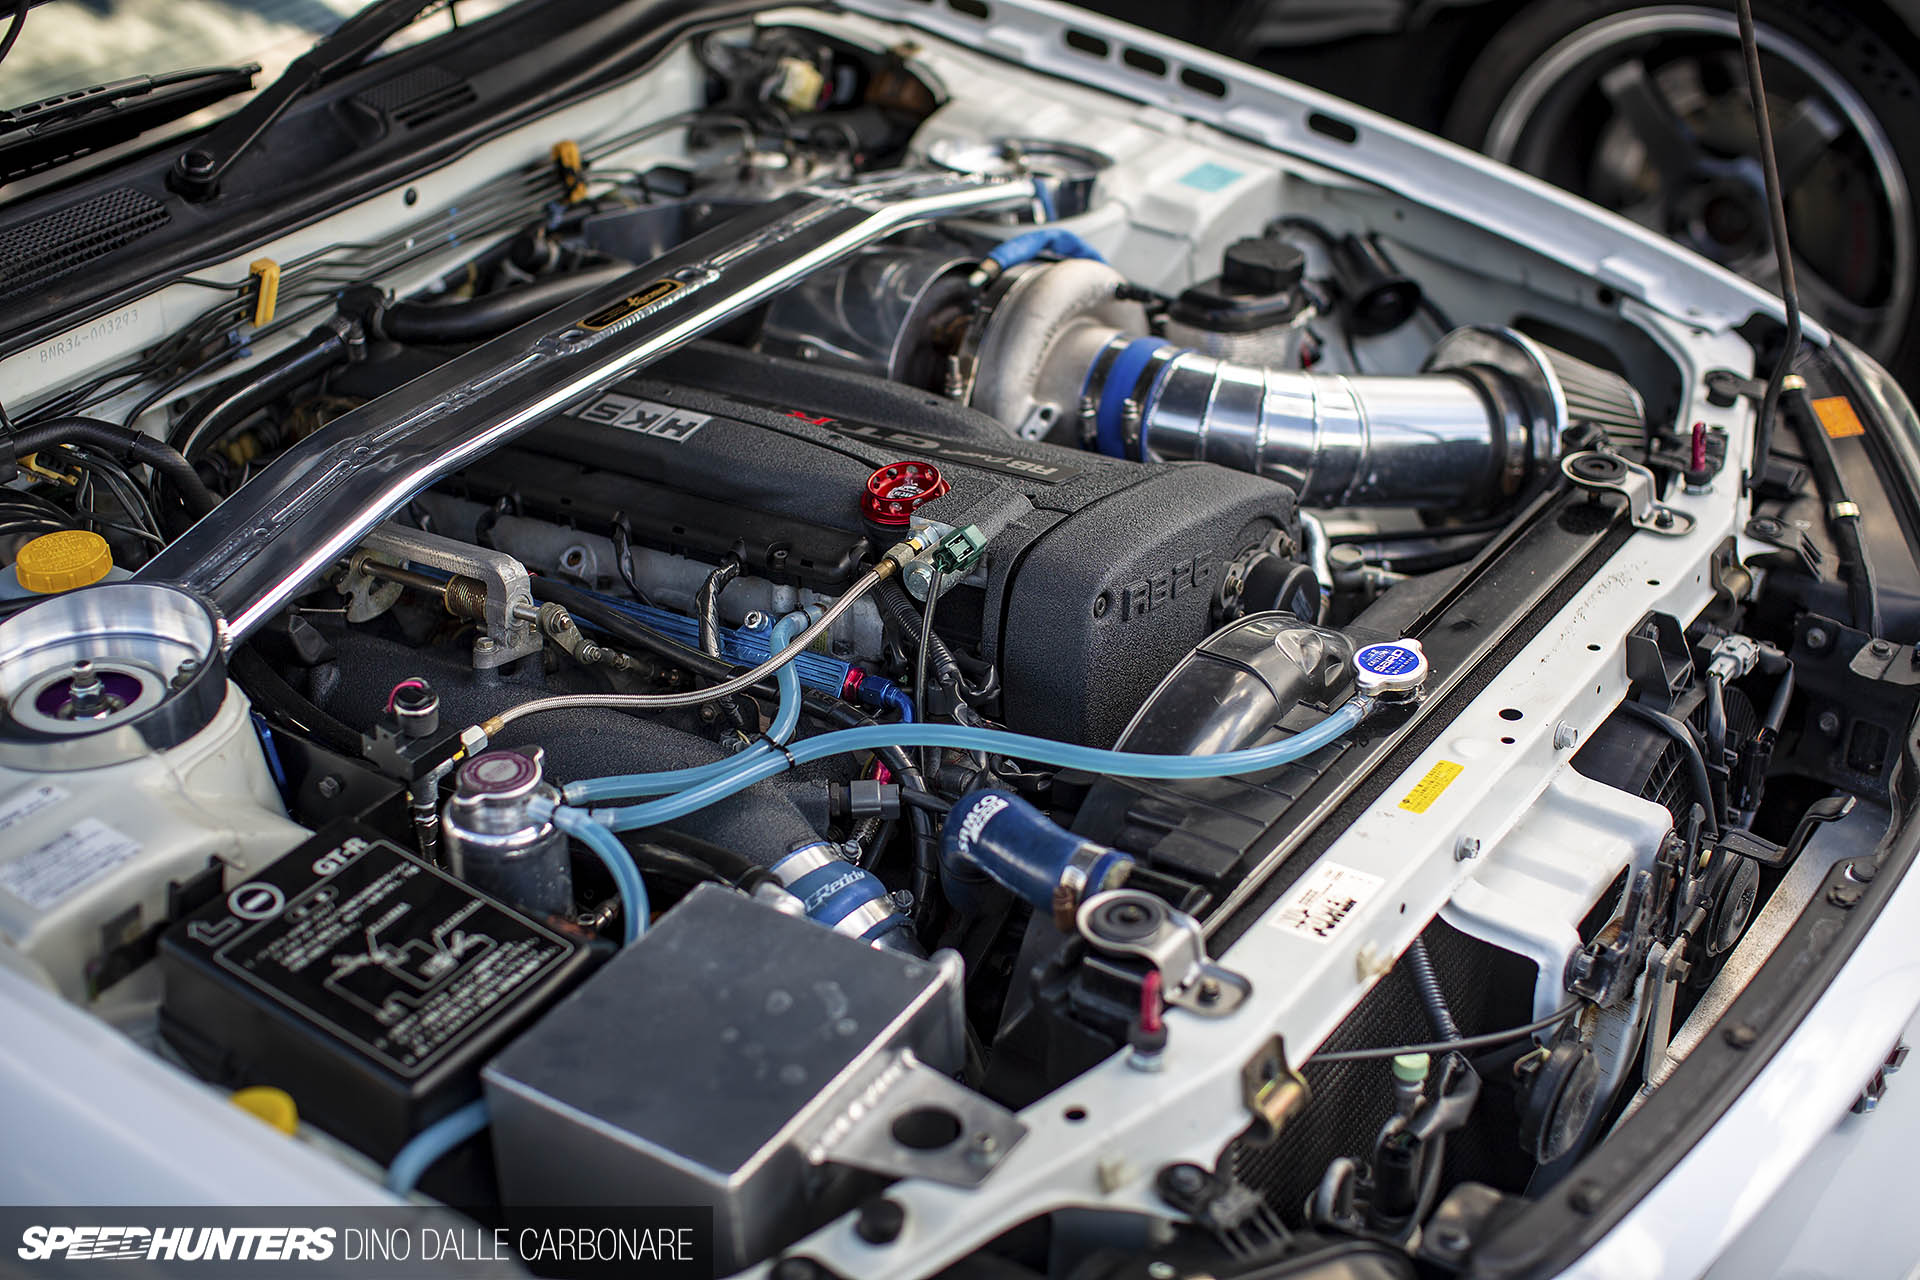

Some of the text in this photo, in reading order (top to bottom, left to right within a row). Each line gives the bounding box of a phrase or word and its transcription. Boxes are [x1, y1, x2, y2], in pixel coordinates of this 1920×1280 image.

[584, 400, 700, 439] HKS
[1121, 549, 1217, 622] RB26
[312, 837, 368, 876] GT-R
[804, 870, 866, 912] GReddy
